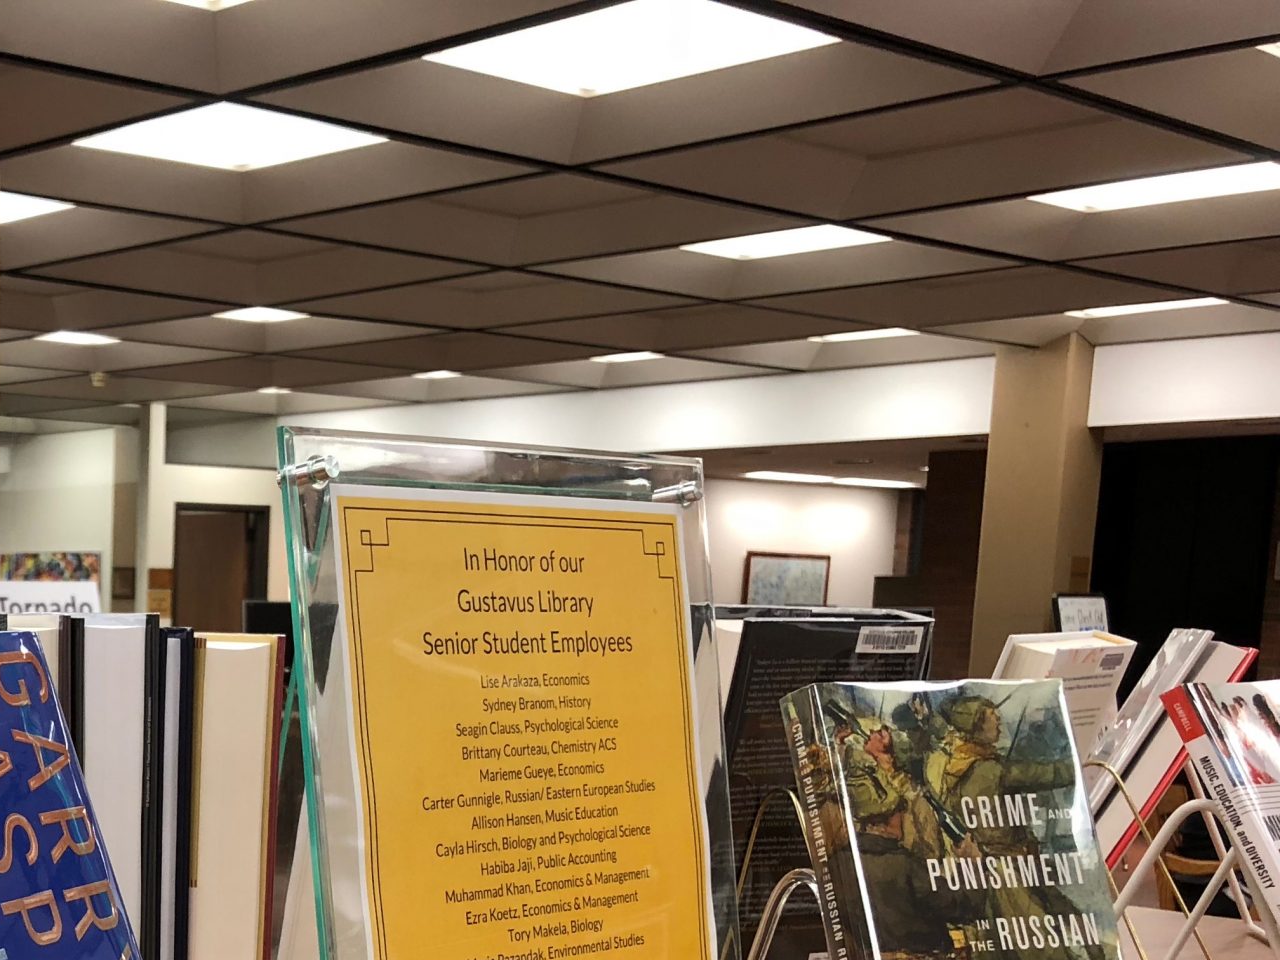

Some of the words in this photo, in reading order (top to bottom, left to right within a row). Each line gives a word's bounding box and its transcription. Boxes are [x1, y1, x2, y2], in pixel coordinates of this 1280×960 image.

[463, 546, 481, 572] In
[483, 547, 536, 573] Honor
[539, 549, 556, 573] of
[558, 556, 585, 573] our
[457, 589, 535, 613] Gustavus
[537, 589, 594, 618] Library
[422, 631, 479, 656] Senior
[482, 630, 548, 655] Student
[550, 630, 633, 658] Employees
[482, 697, 517, 715] Sydney
[518, 696, 558, 711] Branom,
[558, 695, 592, 710] History
[455, 721, 488, 739] Seagin
[489, 720, 523, 736] Clauss,
[524, 717, 585, 736] Psychological
[585, 716, 619, 730] Science
[461, 745, 502, 761] Brittany
[502, 743, 550, 758] Courteau,
[550, 739, 597, 755] Chemistry
[598, 737, 617, 751] ACS
[791, 723, 809, 767] CRIME
[479, 767, 523, 783] Marieme
[523, 765, 557, 781] Gueye,
[557, 761, 605, 777] Economics
[422, 796, 456, 811] Carter
[545, 786, 582, 801] Eastern
[582, 783, 625, 798] European
[624, 778, 656, 794] Studies
[471, 815, 505, 831] Allison
[505, 812, 544, 827] Hansen,
[544, 807, 574, 823] Music
[574, 804, 619, 821] Education
[803, 777, 828, 863] PUNISHMENT
[961, 793, 1043, 829] CRIME
[1048, 808, 1072, 820] AND
[1199, 755, 1215, 786] MUSIC,
[1213, 783, 1237, 832] EDUCATION,
[1236, 827, 1248, 847] and
[1244, 845, 1276, 890] DIVERSITY
[480, 860, 516, 876] Habiba
[536, 853, 567, 870] Public
[567, 848, 618, 866] Accounting
[926, 852, 1084, 892] PUNISHMENT
[444, 883, 504, 904] Muhammad
[505, 881, 534, 897] Khan,
[534, 874, 585, 893] Economics
[585, 872, 594, 887] &
[594, 869, 650, 885] Management
[823, 883, 843, 942] RUSSIAN
[976, 919, 990, 930] IN
[506, 928, 531, 943] Tory
[532, 921, 570, 939] Makela,
[570, 918, 604, 934] Biology
[969, 940, 996, 952] THE
[996, 912, 1100, 951] RUSSIAN
[547, 936, 613, 960] Environmental
[613, 933, 645, 950] Studies
